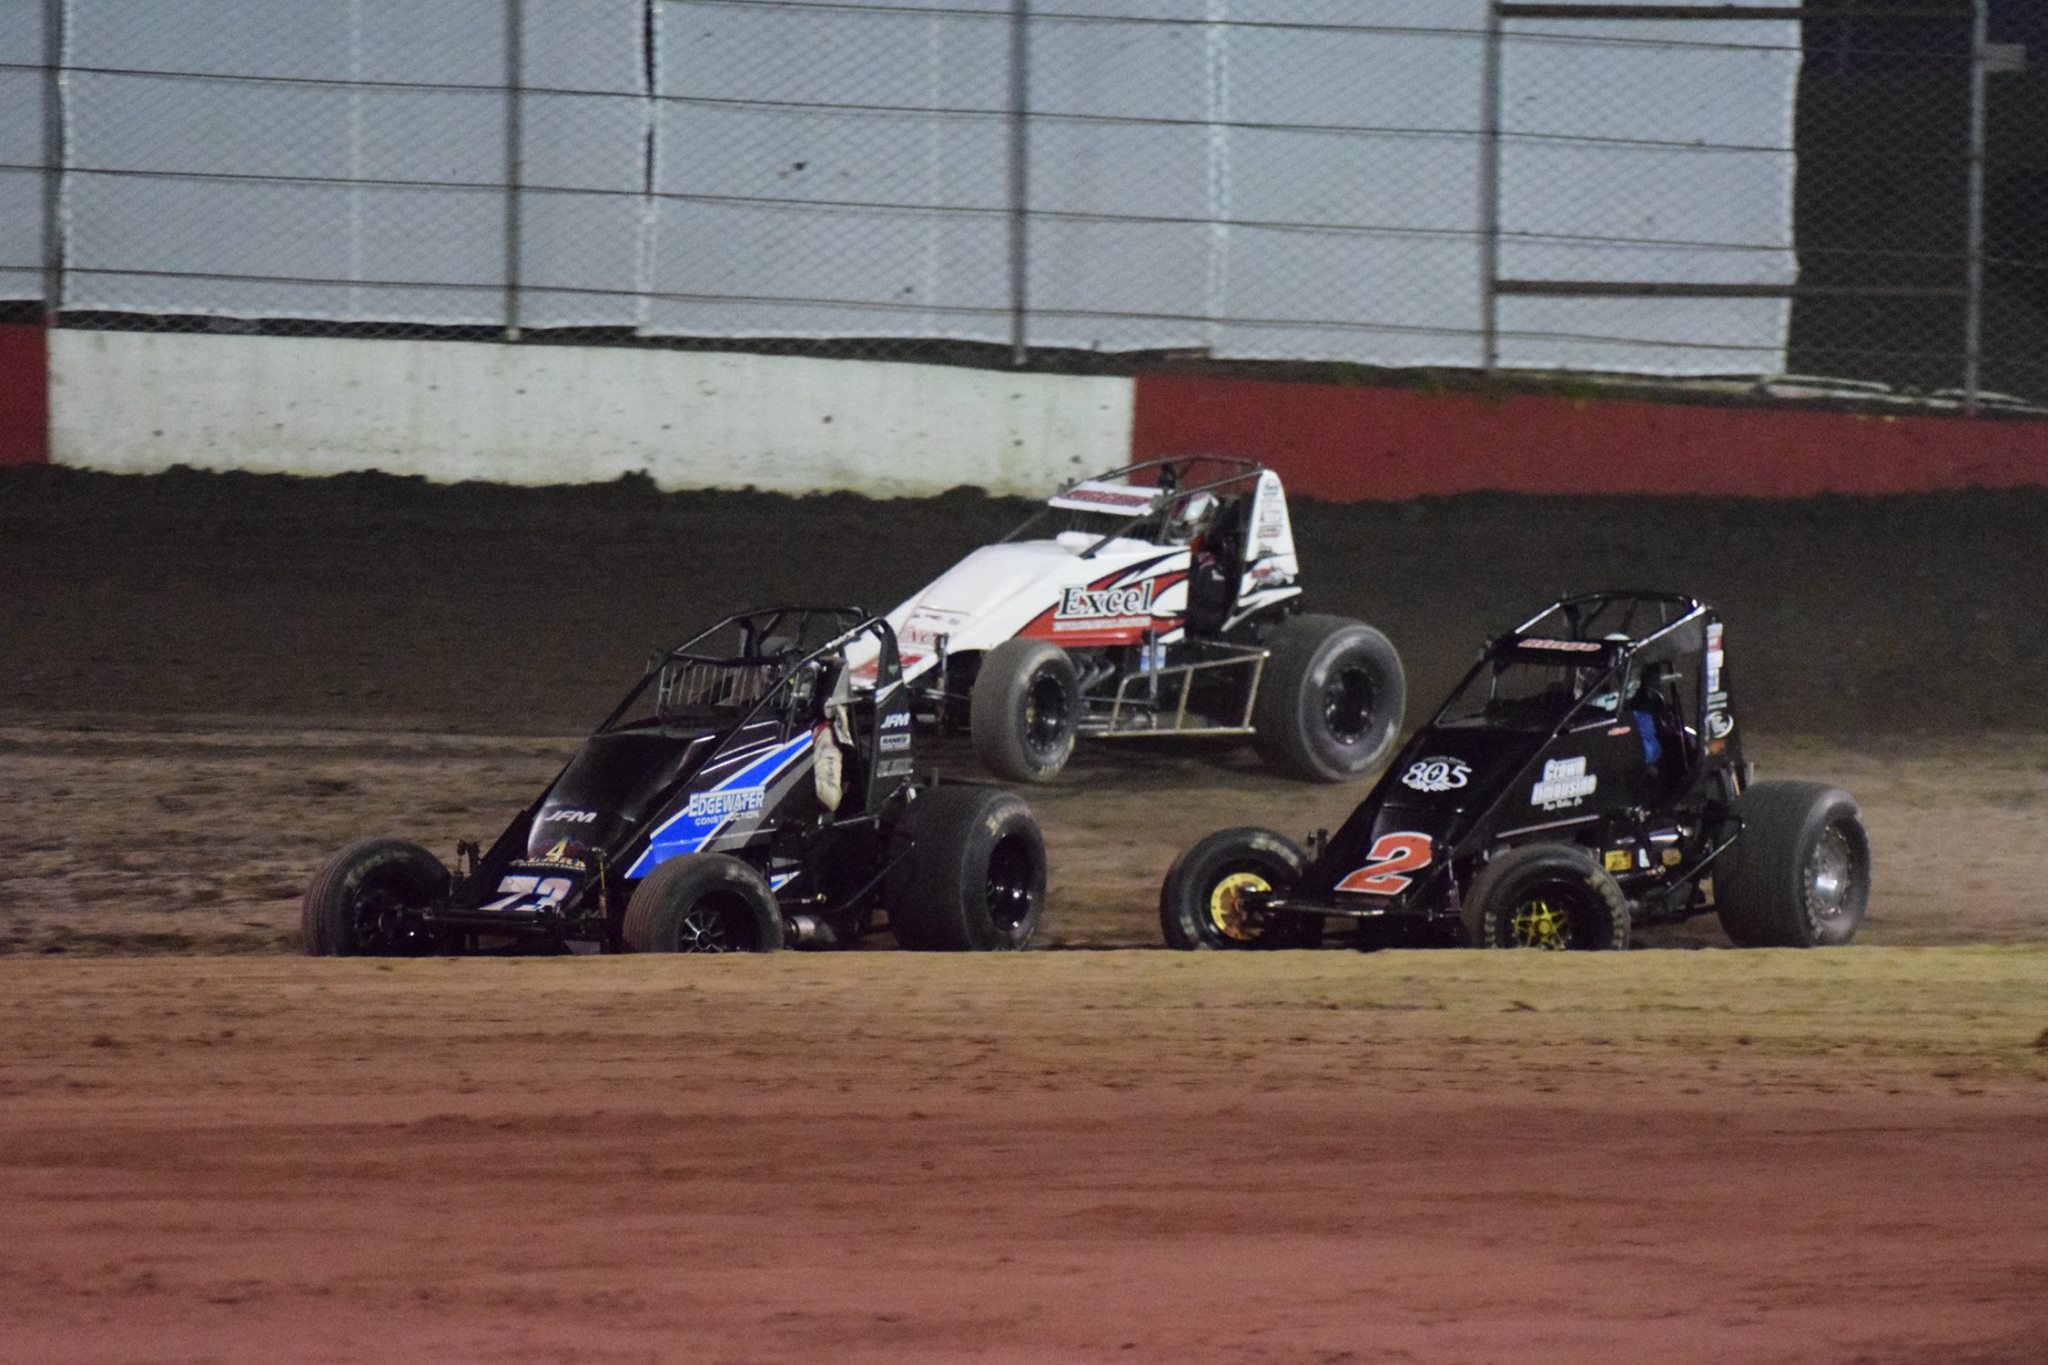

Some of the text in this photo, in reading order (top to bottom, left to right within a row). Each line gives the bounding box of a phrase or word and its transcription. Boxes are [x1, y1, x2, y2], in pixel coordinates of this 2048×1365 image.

[1055, 579, 1155, 618] Excel
[880, 712, 911, 729] JFM
[1402, 762, 1472, 789] 805
[688, 788, 765, 817] EDGEWATER
[543, 810, 598, 823] JFM
[694, 810, 760, 827] CONSTUCTION
[1333, 831, 1433, 895] 2
